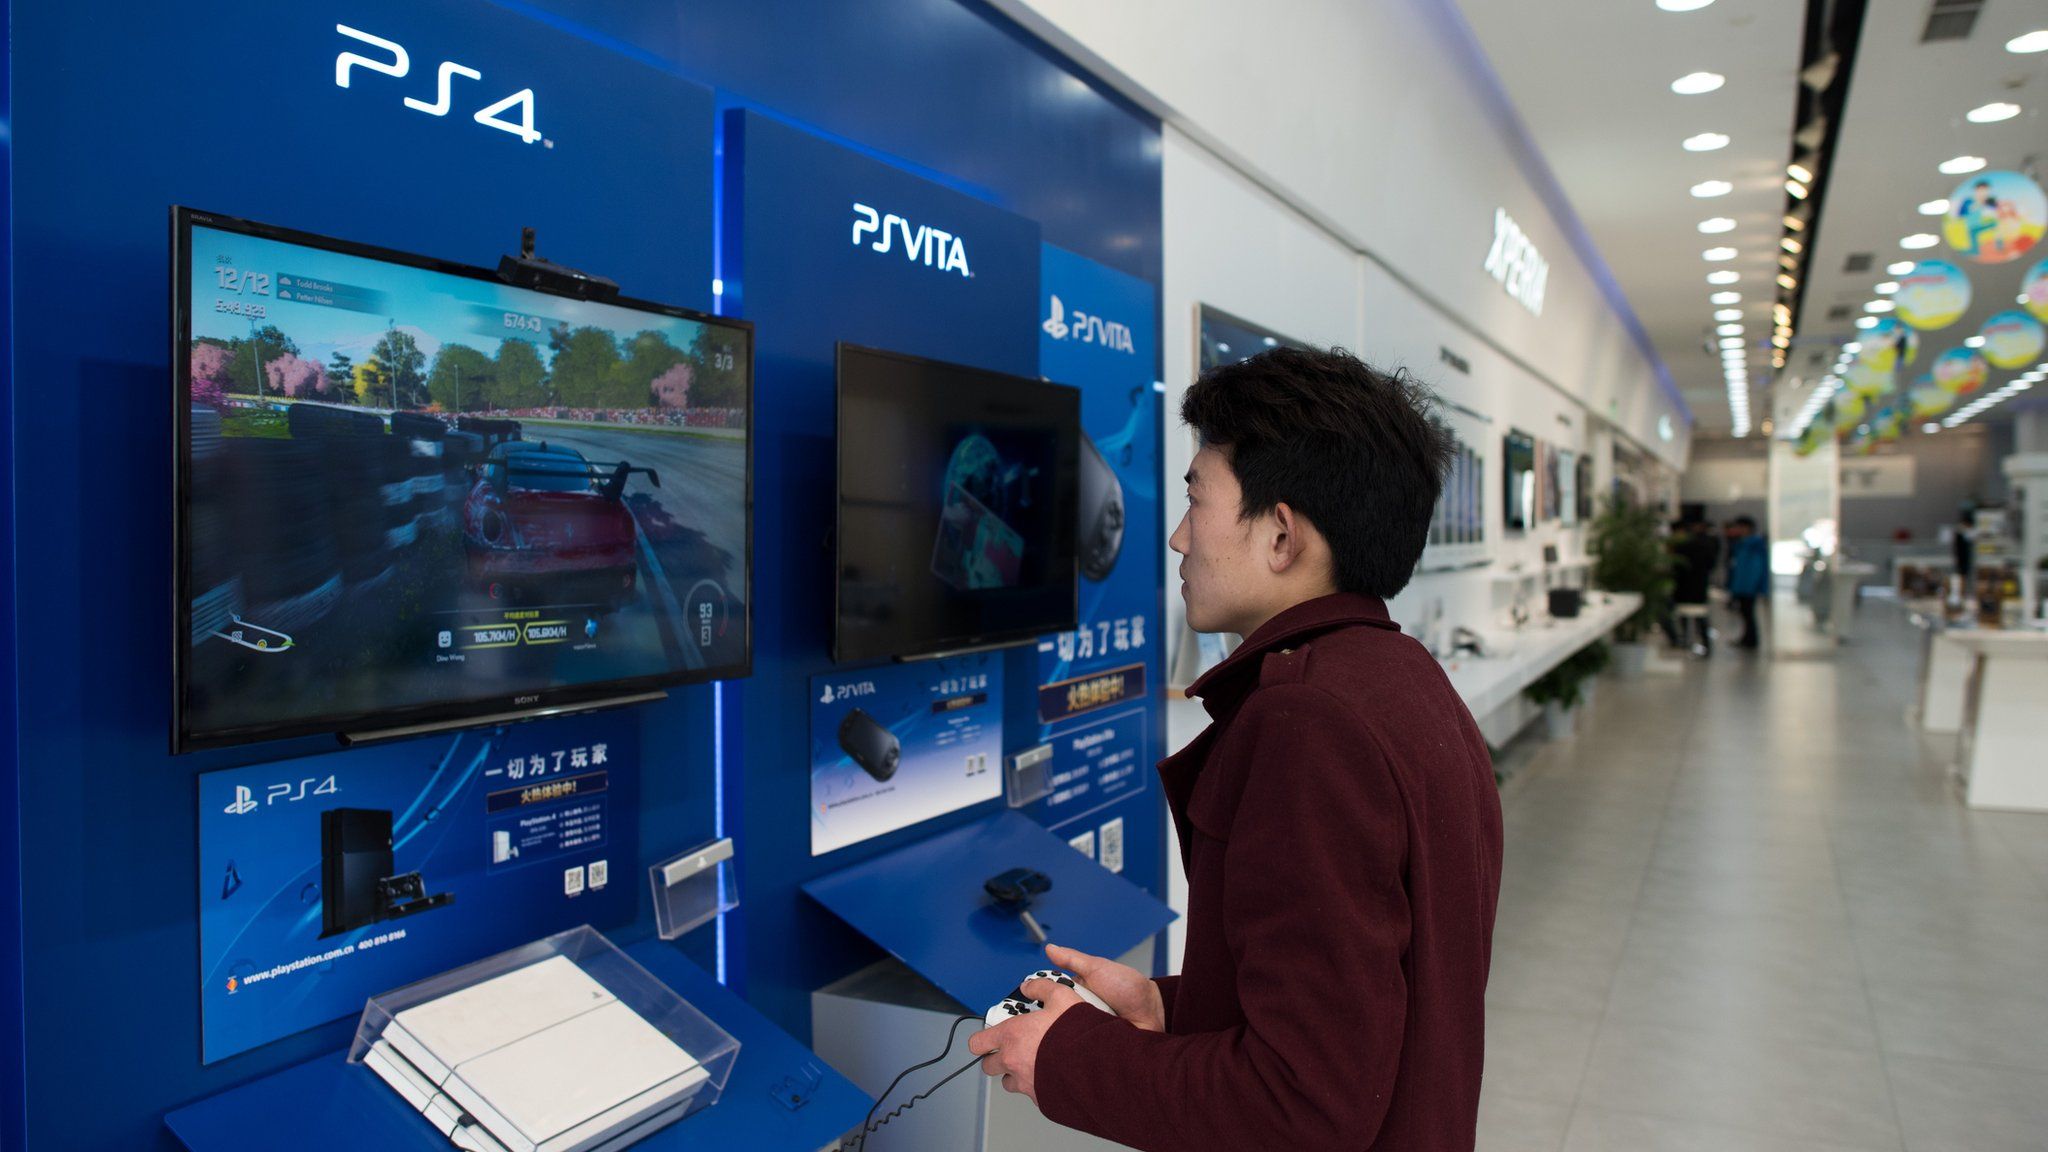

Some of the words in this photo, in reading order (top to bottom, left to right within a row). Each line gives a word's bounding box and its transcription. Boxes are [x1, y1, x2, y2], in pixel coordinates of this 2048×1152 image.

[335, 23, 542, 144] PS4
[214, 265, 270, 296] 12/12
[714, 353, 734, 371] 3/3
[699, 602, 713, 619] 93
[514, 695, 540, 705] SONY
[485, 743, 608, 780] 一切为了玩家
[266, 775, 338, 806] PS4
[243, 945, 355, 985] www.playstation.com.cn
